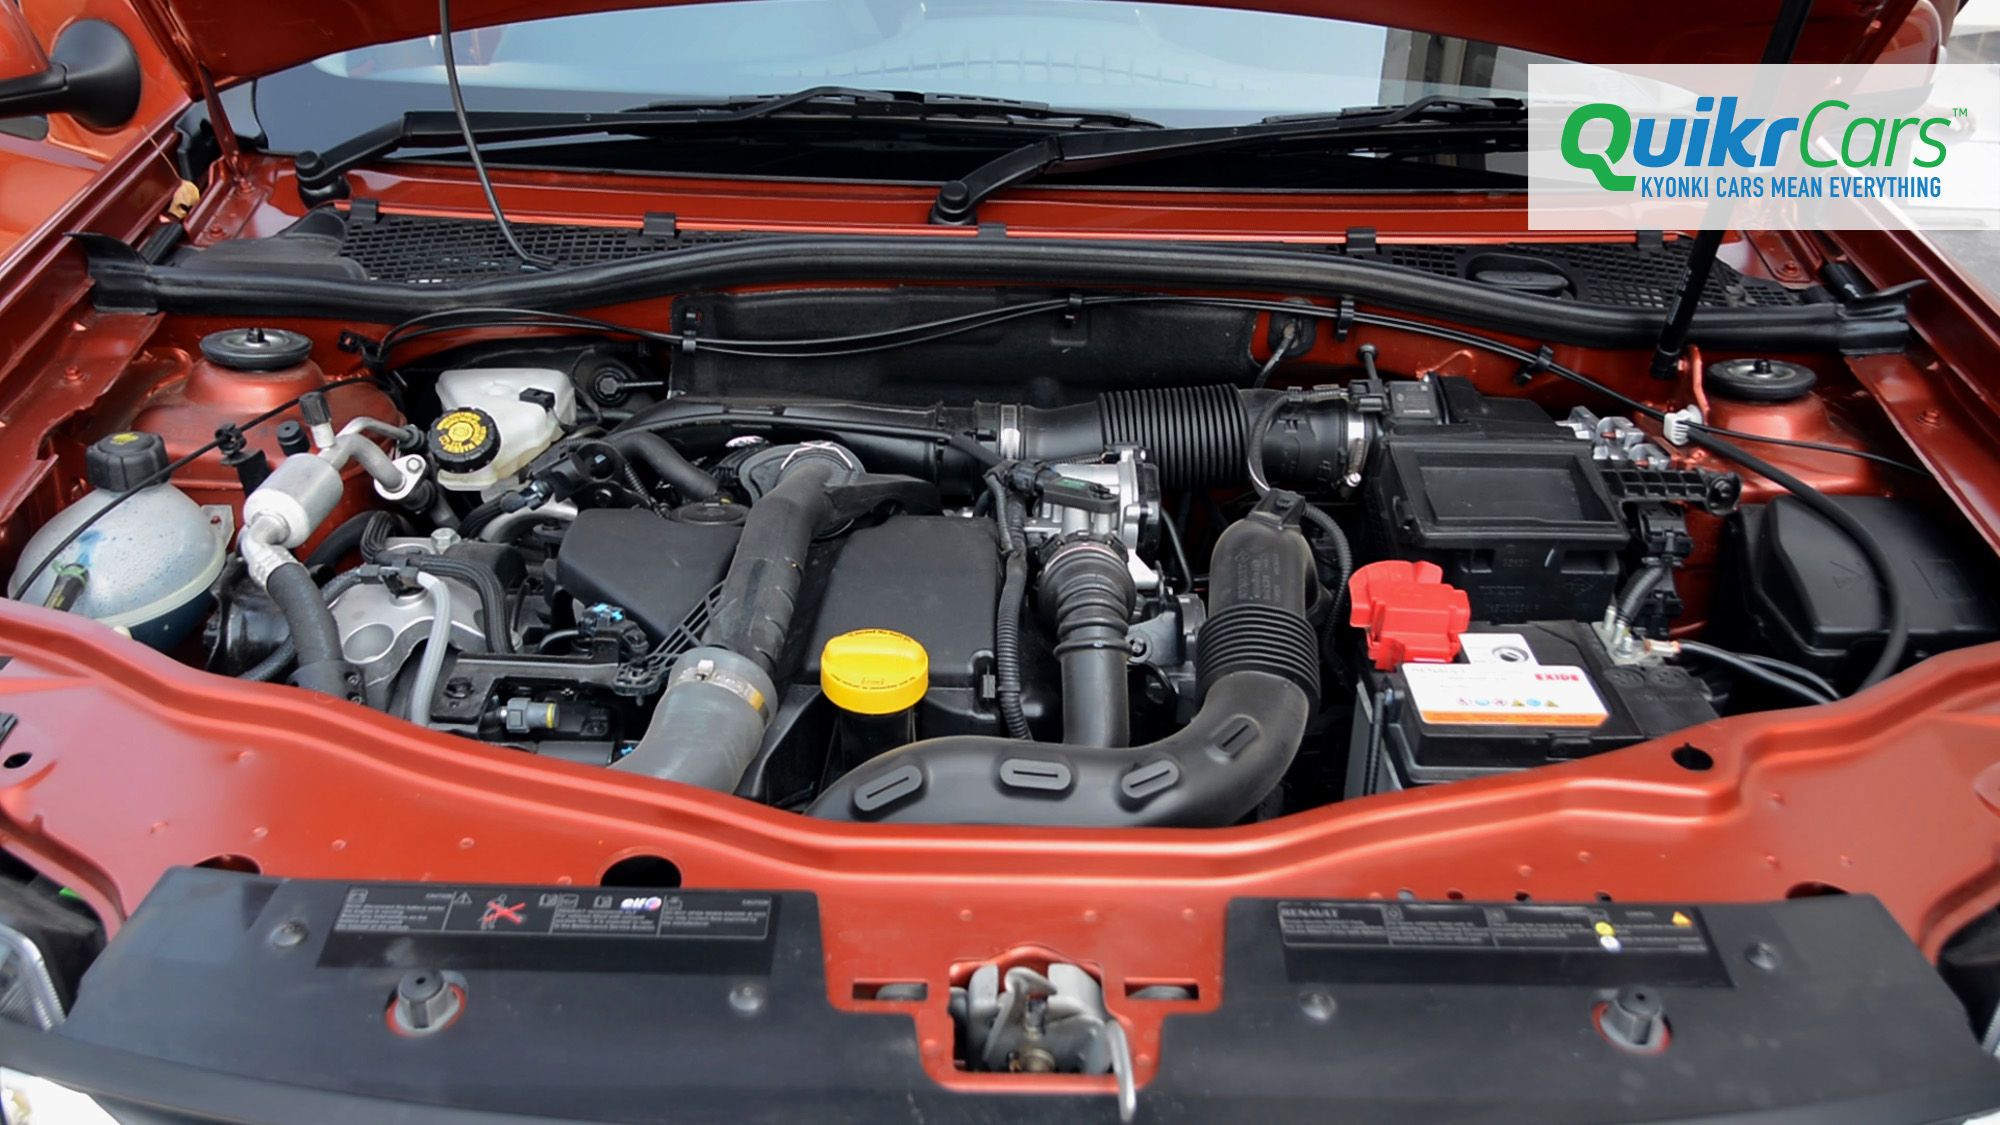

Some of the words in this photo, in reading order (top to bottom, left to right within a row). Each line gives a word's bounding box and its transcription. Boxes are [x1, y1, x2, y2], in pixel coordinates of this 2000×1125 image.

[1535, 673, 1579, 681] EXIDE
[620, 897, 647, 909] elf
[1280, 909, 1338, 918] RENAULT
